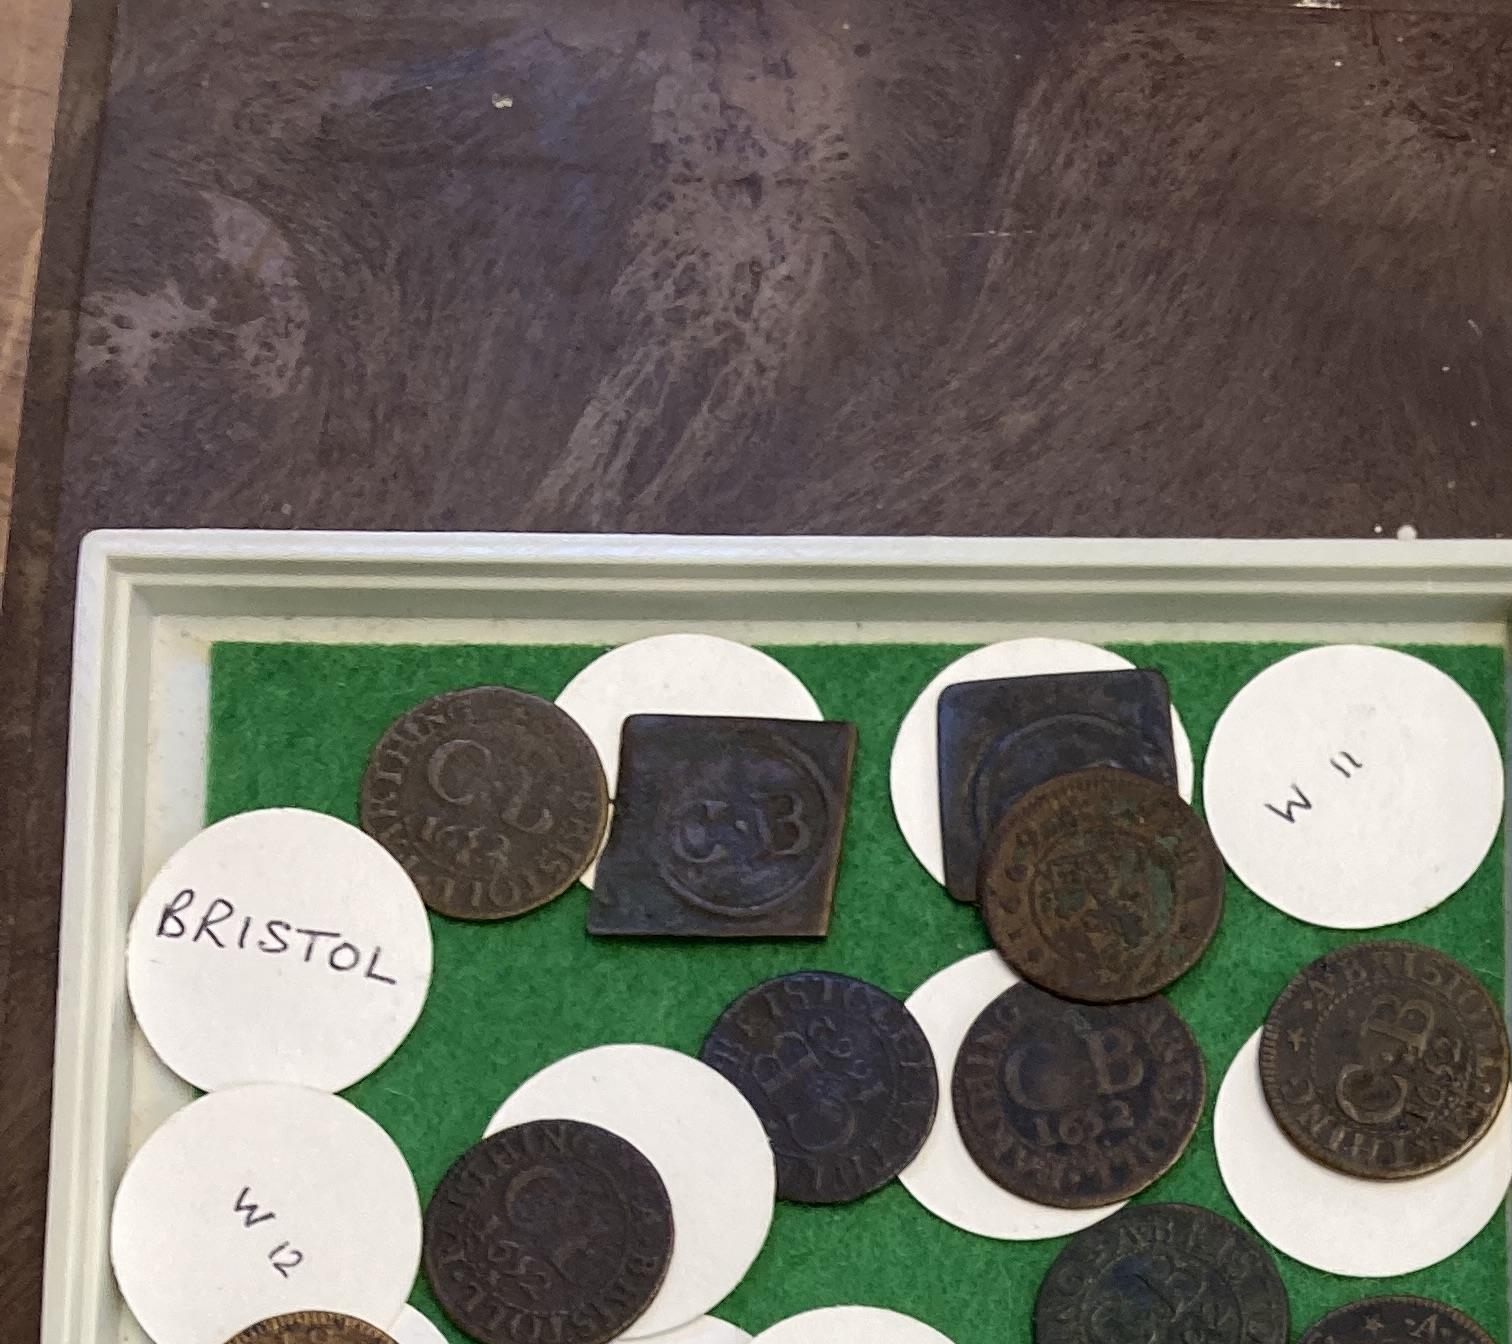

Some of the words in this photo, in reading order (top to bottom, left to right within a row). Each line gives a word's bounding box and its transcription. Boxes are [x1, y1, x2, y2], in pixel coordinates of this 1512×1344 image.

[1264, 783, 1313, 824] W
[1329, 751, 1363, 779] 11
[155, 888, 398, 986] BRISTOL
[233, 1186, 277, 1228] W
[267, 1240, 304, 1279] 12
